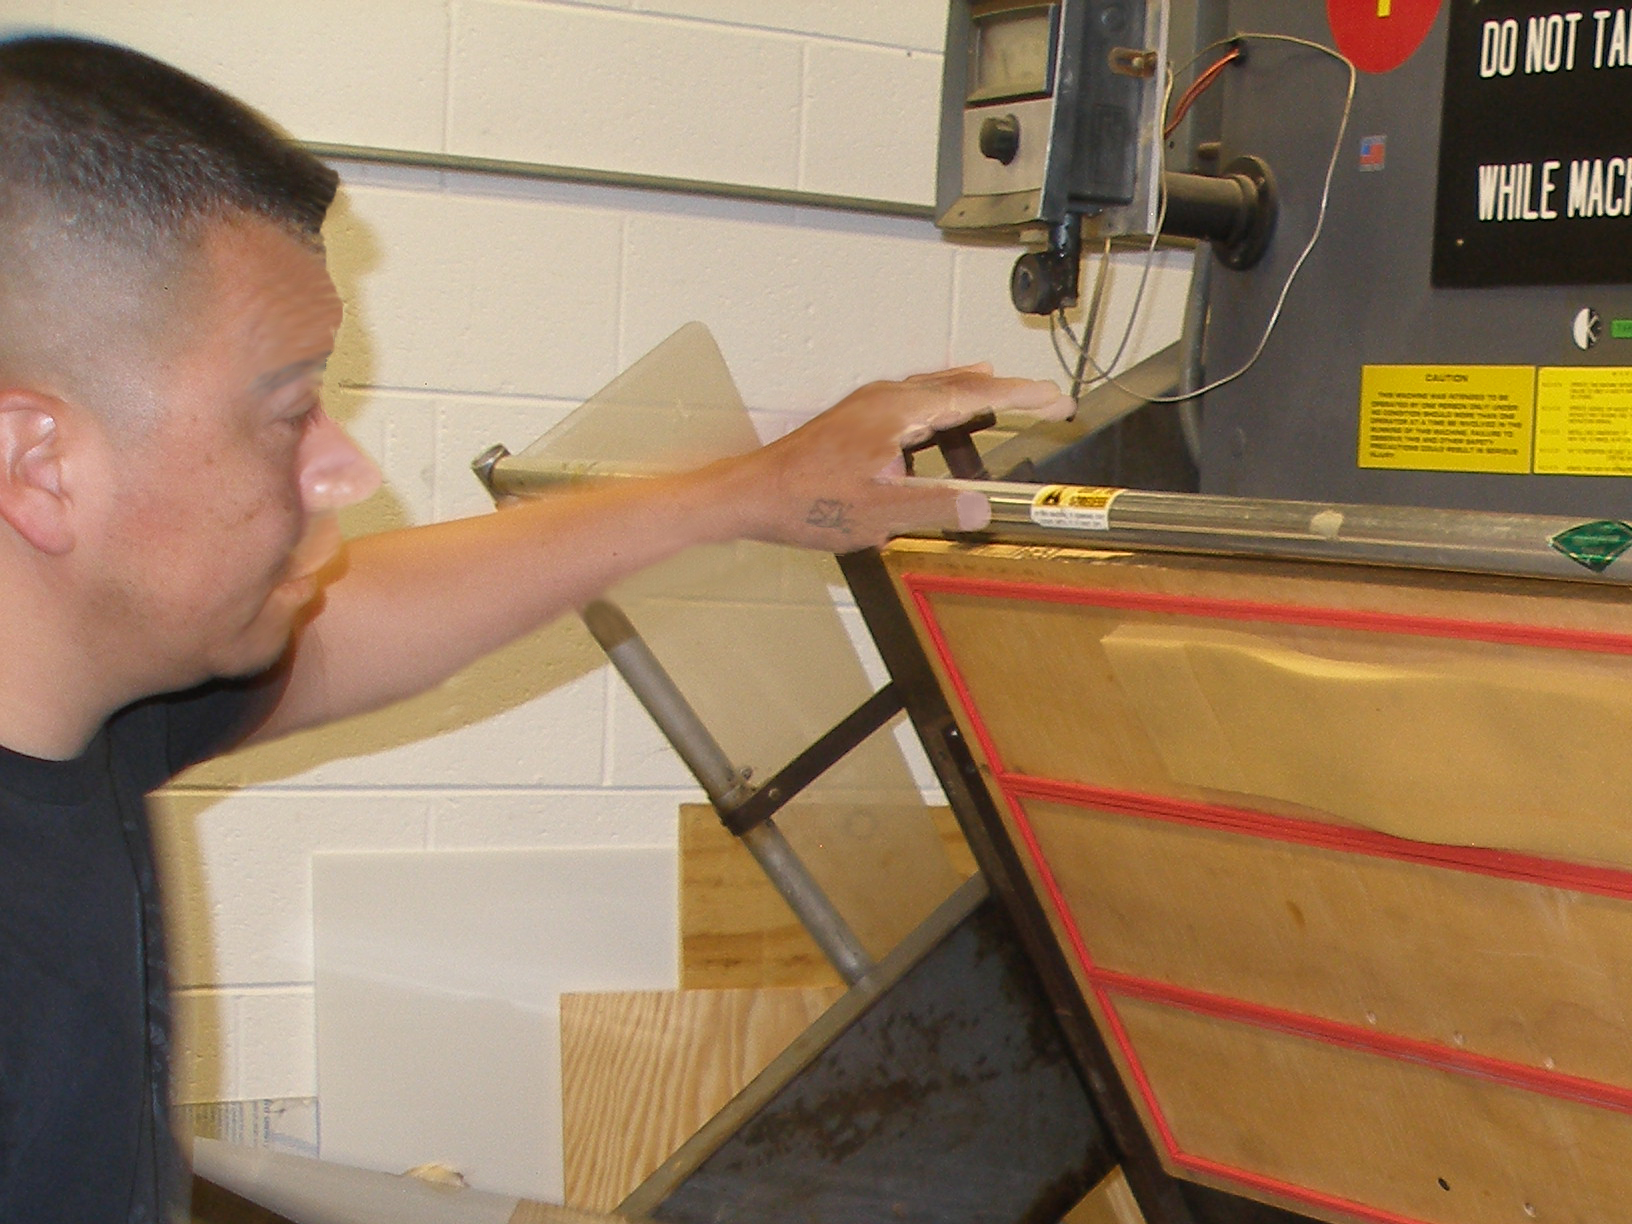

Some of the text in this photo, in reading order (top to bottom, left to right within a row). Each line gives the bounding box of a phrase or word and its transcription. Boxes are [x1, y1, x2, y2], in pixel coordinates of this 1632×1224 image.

[1479, 19, 1518, 78] DO
[1524, 12, 1583, 75] NOT
[1478, 161, 1561, 221] WHILE
[1425, 374, 1468, 382] CAUTION
